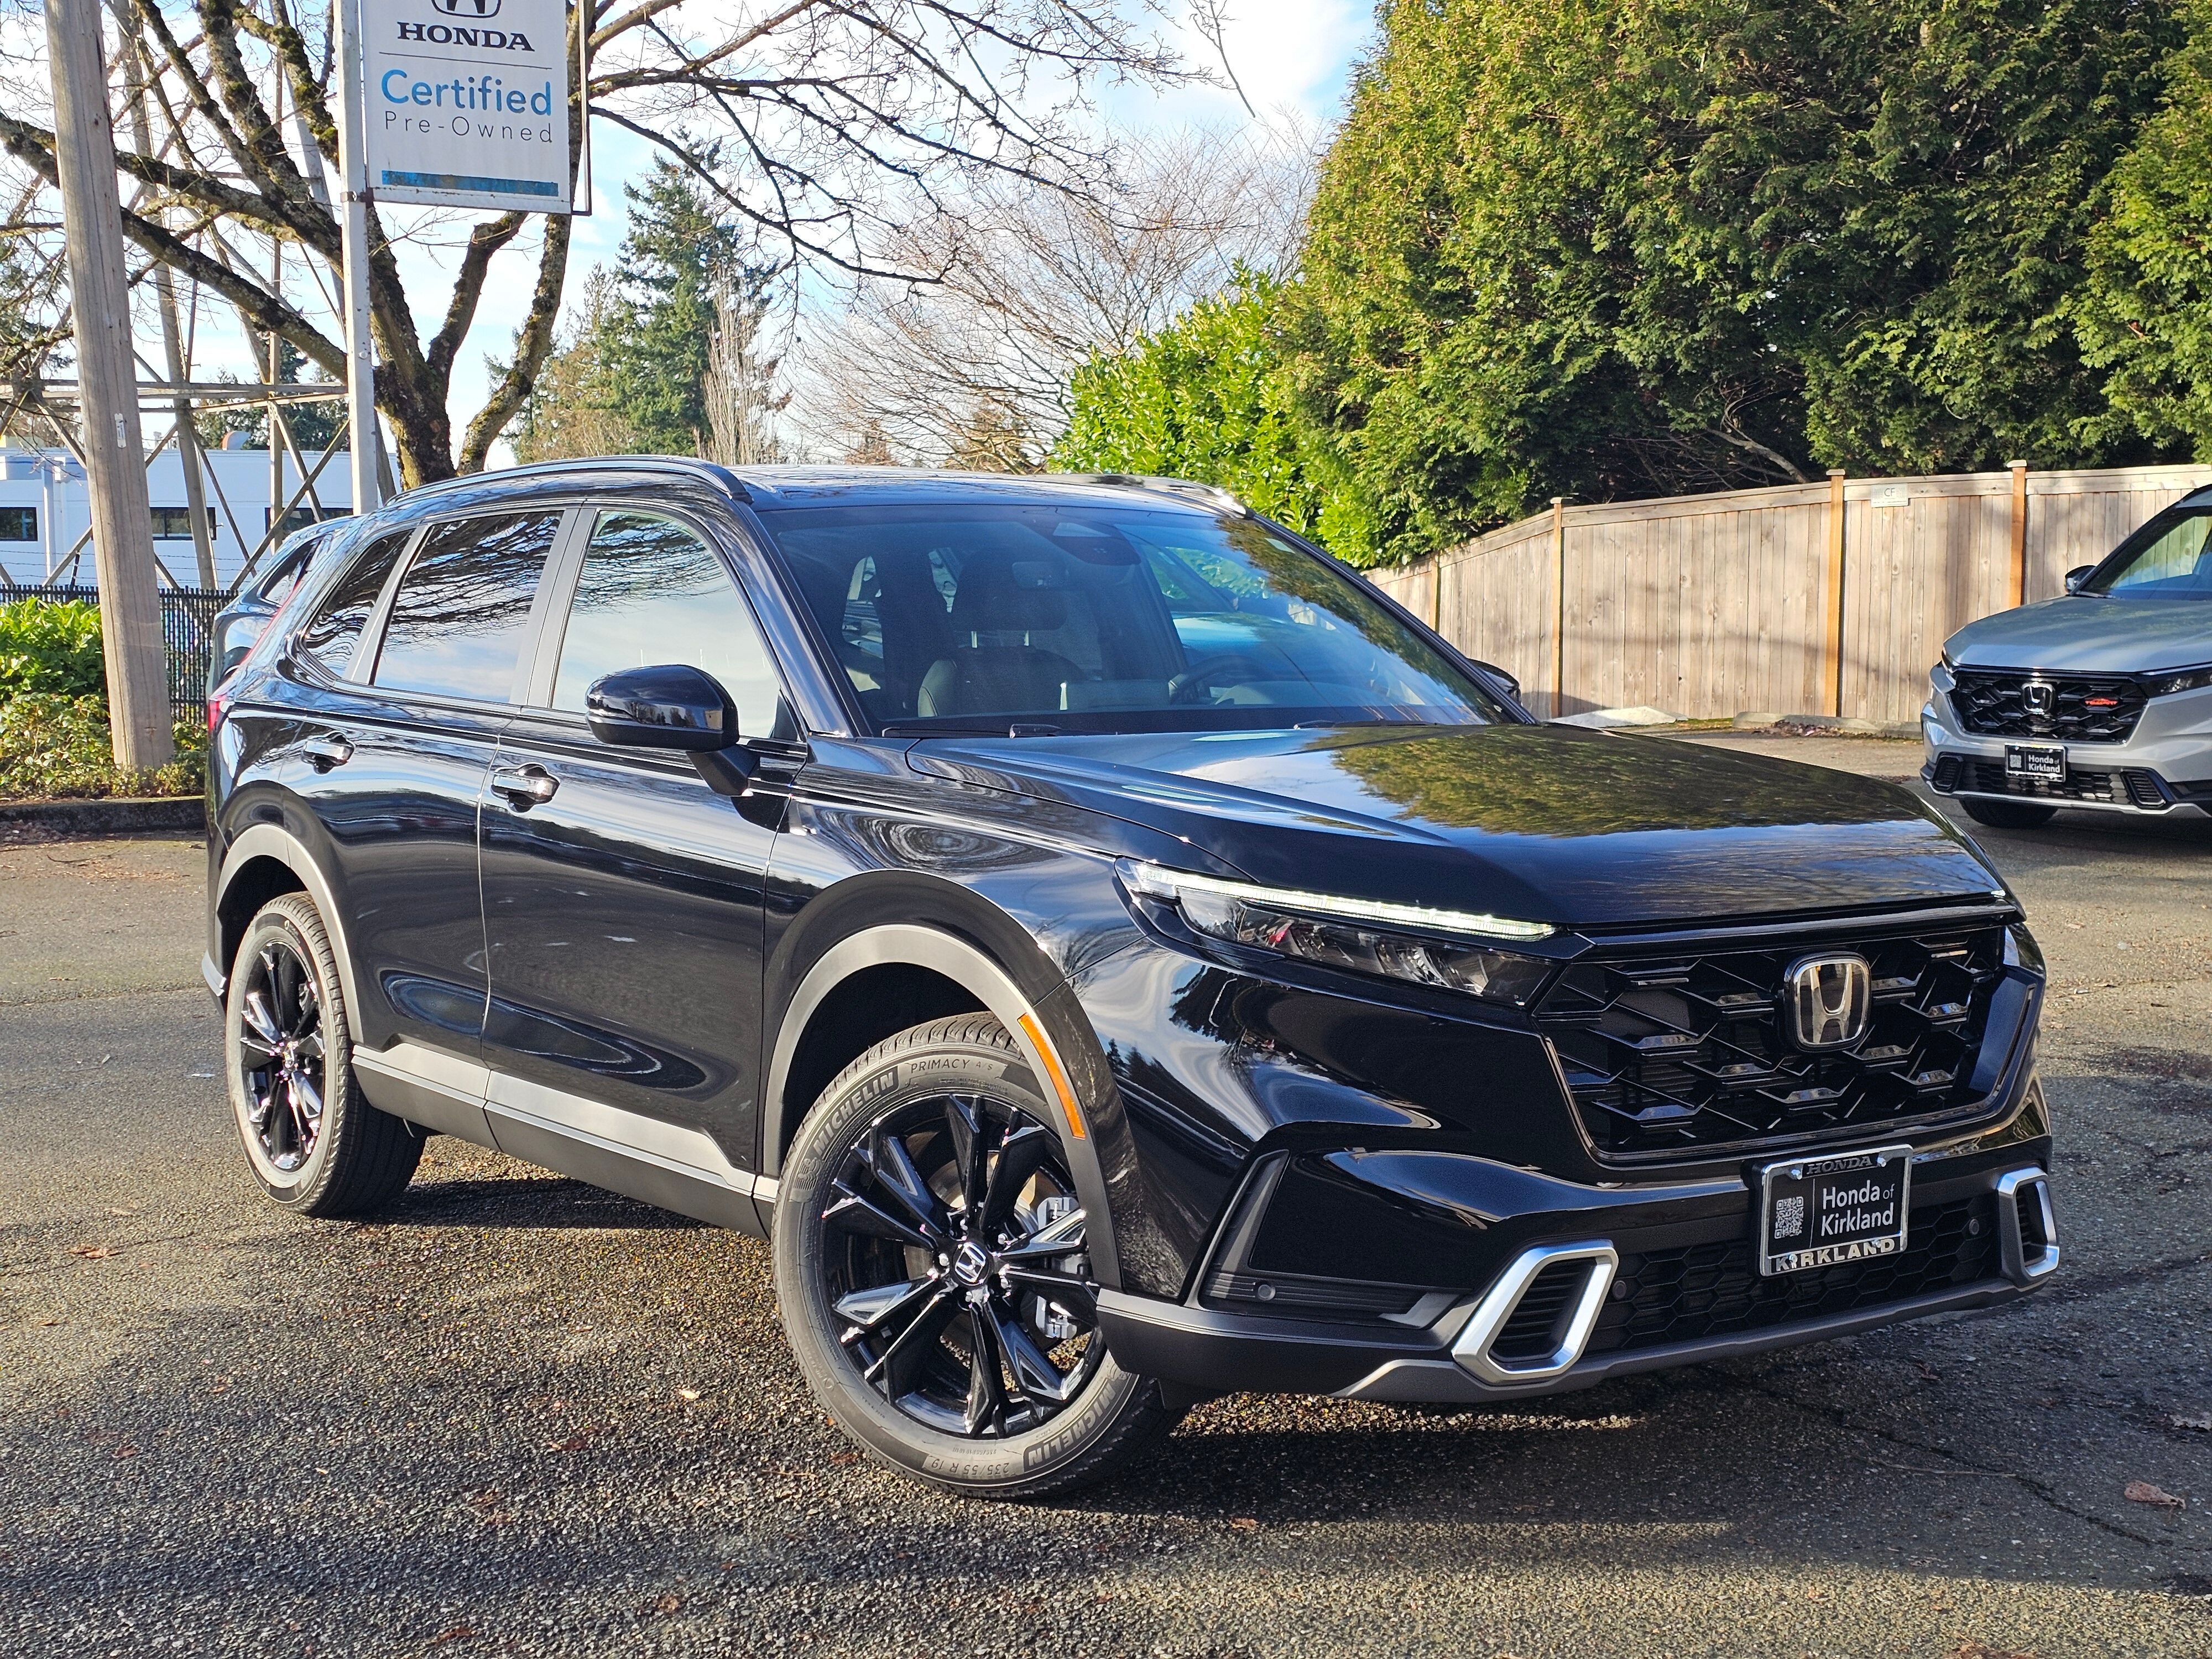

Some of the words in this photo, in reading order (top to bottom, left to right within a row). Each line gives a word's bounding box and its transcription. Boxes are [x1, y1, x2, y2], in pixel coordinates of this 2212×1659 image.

[397, 22, 535, 52] HONDA
[381, 69, 551, 116] Certified
[385, 111, 552, 143] Pre-Owned
[1884, 488, 1895, 497] CF
[2028, 754, 2054, 764] Honda
[2028, 763, 2060, 773] Kirkland
[911, 1058, 970, 1073] PRIMACY
[813, 1072, 895, 1156] MICHELIN
[1806, 1156, 1874, 1176] HONDA
[1823, 1180, 1880, 1210] Honda
[1882, 1183, 1895, 1199] of
[1821, 1202, 1894, 1237] Kirkland
[1027, 1386, 1117, 1467] MICHELIN
